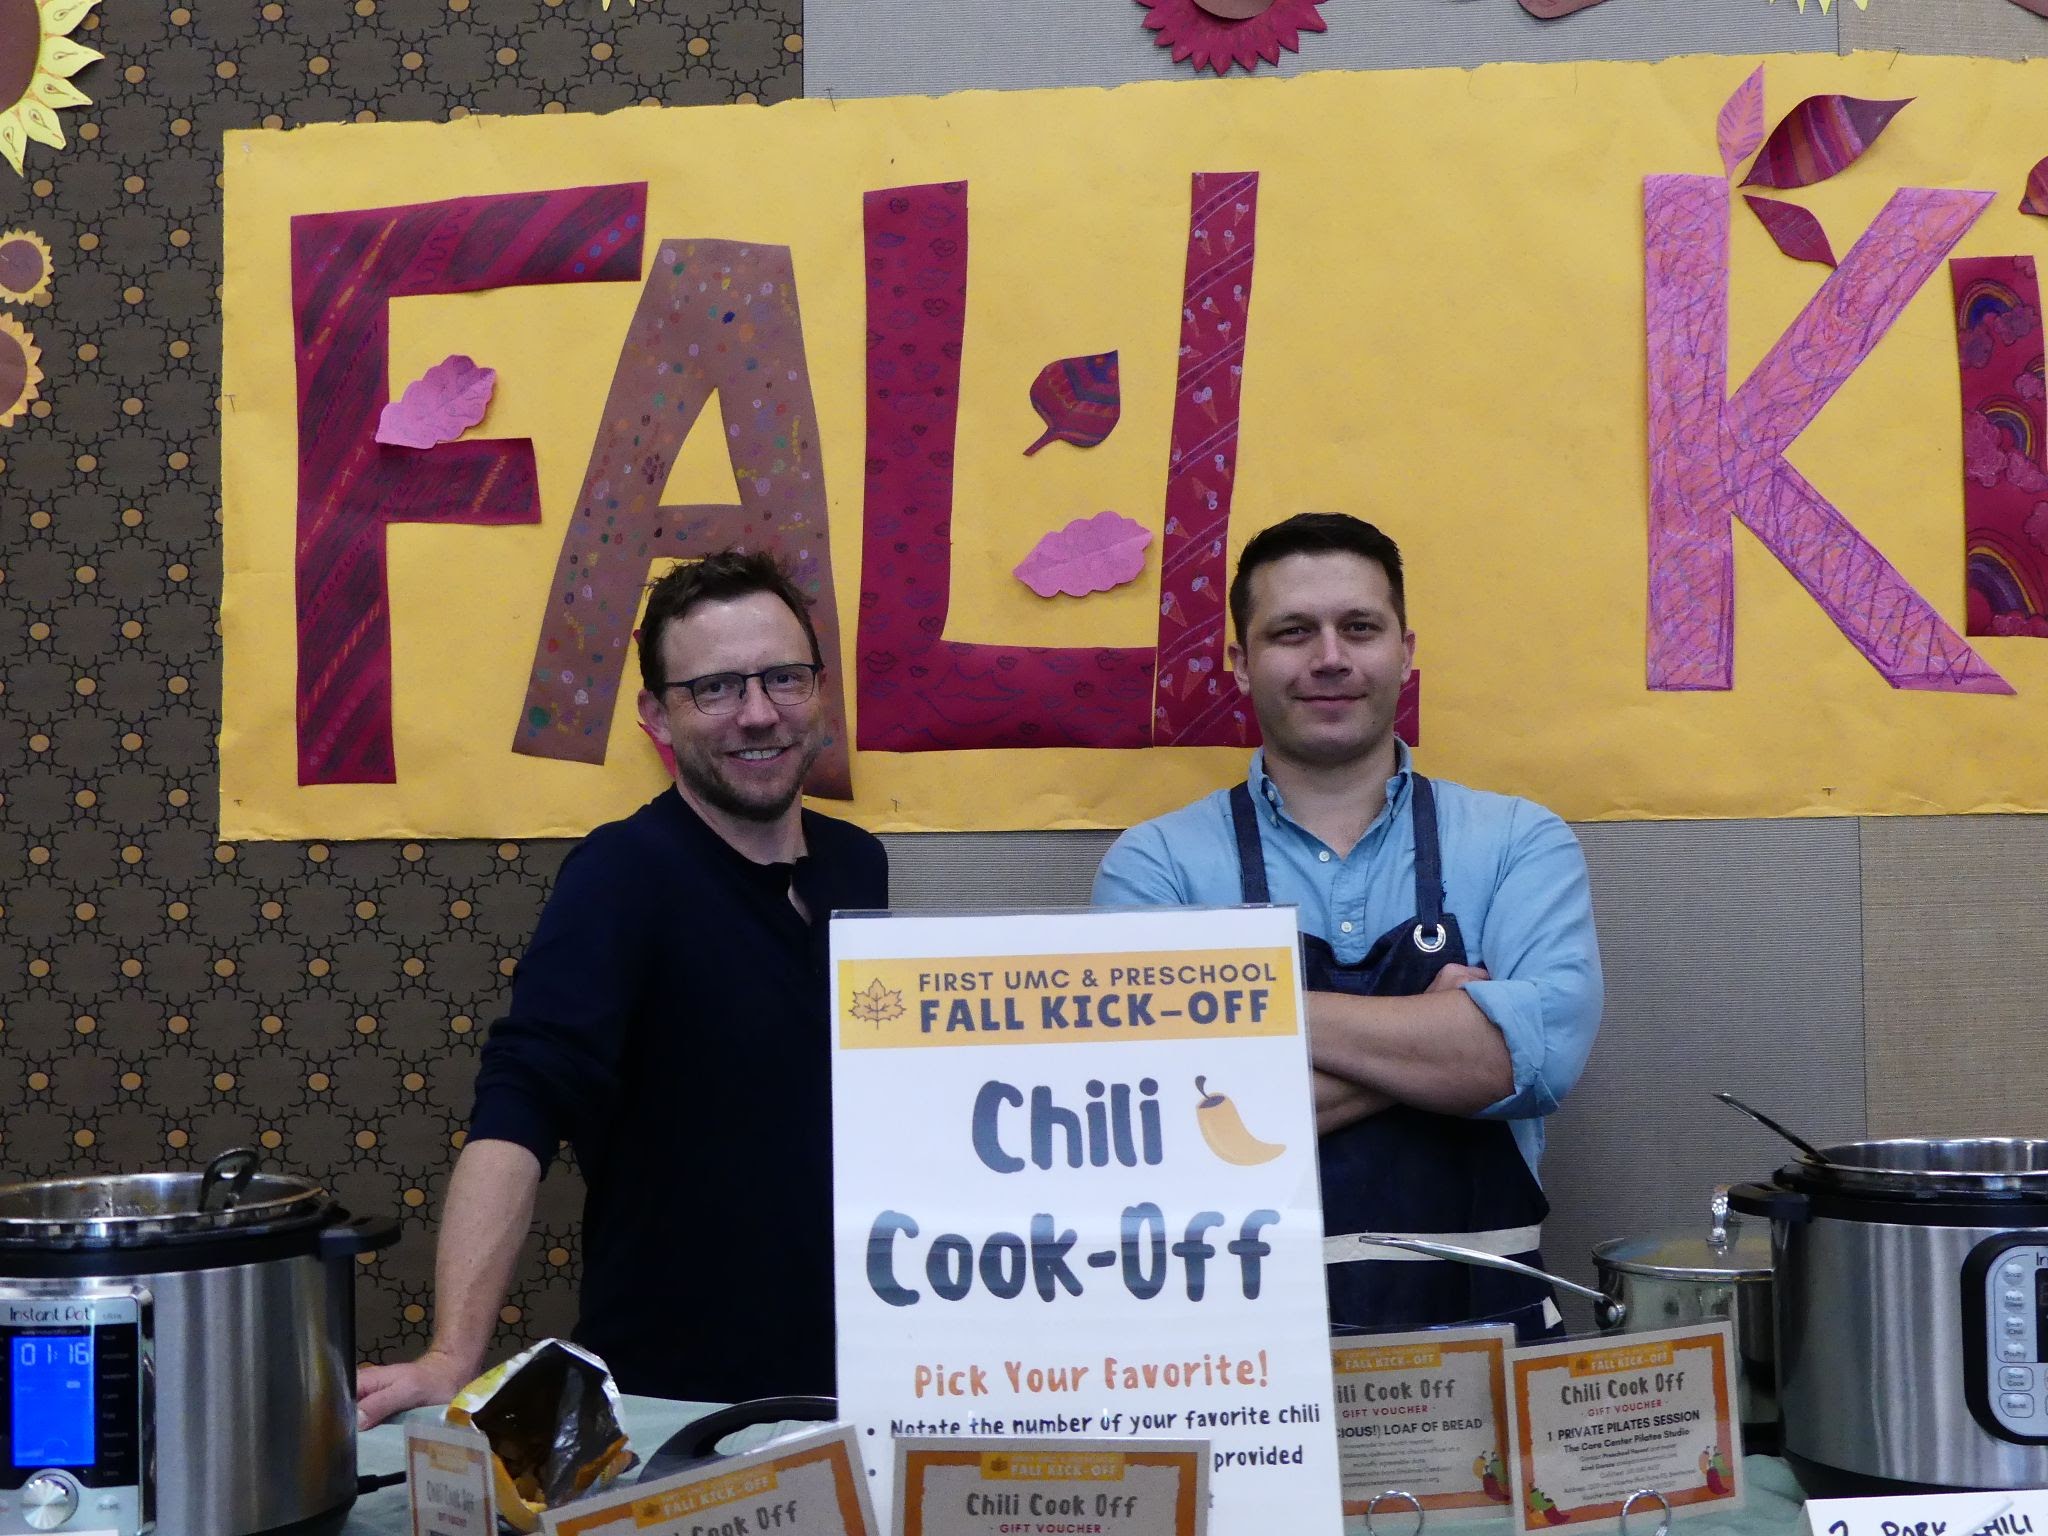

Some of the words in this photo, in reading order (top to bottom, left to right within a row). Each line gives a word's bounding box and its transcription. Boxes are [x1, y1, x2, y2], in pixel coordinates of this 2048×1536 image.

[291, 171, 1419, 801] FALL
[918, 970, 994, 992] FIRST
[1004, 969, 1071, 990] UMC
[1082, 967, 1098, 988] &
[1110, 962, 1277, 987] PRESCHOOL
[919, 997, 1025, 1033] FALL
[1041, 989, 1269, 1029] KICK-OFF
[972, 1077, 1163, 1174] Chili
[866, 1201, 1281, 1307] Cook-Off
[10, 1306, 58, 1321] Instant
[65, 1306, 90, 1321] Pot
[915, 1363, 989, 1399] Pick
[1004, 1360, 1089, 1393] Your
[1104, 1350, 1268, 1390] Favorite!
[1561, 1382, 1601, 1405] Chili
[1607, 1376, 1649, 1399] Cook
[1654, 1371, 1685, 1393] Off
[1337, 1384, 1357, 1403] ili
[1364, 1381, 1413, 1402] Cook
[1420, 1378, 1456, 1399] Off
[890, 1418, 961, 1435] Notate
[970, 1416, 1004, 1435] the
[1012, 1413, 1092, 1434] number
[1100, 1413, 1123, 1432] of
[1128, 1412, 1177, 1435] your
[1185, 1406, 1271, 1430] favorite
[1278, 1403, 1321, 1424] chili
[1342, 1408, 1367, 1419] GIFT
[1373, 1404, 1429, 1416] VOUCHER
[1588, 1406, 1611, 1417] GIFT
[1614, 1399, 1663, 1414] VOUCHER
[1384, 1422, 1417, 1435] LOAF
[1421, 1421, 1439, 1433] OF
[1442, 1418, 1483, 1432] BREAD
[1558, 1424, 1604, 1441] PRIVATE
[1607, 1416, 1650, 1433] PILATES
[1653, 1409, 1701, 1426] SESSION
[1564, 1443, 1580, 1453] The
[1634, 1432, 1662, 1444] Pilates
[1663, 1427, 1690, 1439] Studio
[1214, 1444, 1303, 1472] provided
[756, 1500, 797, 1530] Off
[967, 1493, 1019, 1516] Chili
[1029, 1493, 1085, 1516] Cook
[1095, 1493, 1138, 1518] Off
[999, 1523, 1030, 1534] GIFT
[1036, 1523, 1101, 1534] VOUCHER
[1973, 1514, 2033, 1536] HILI
